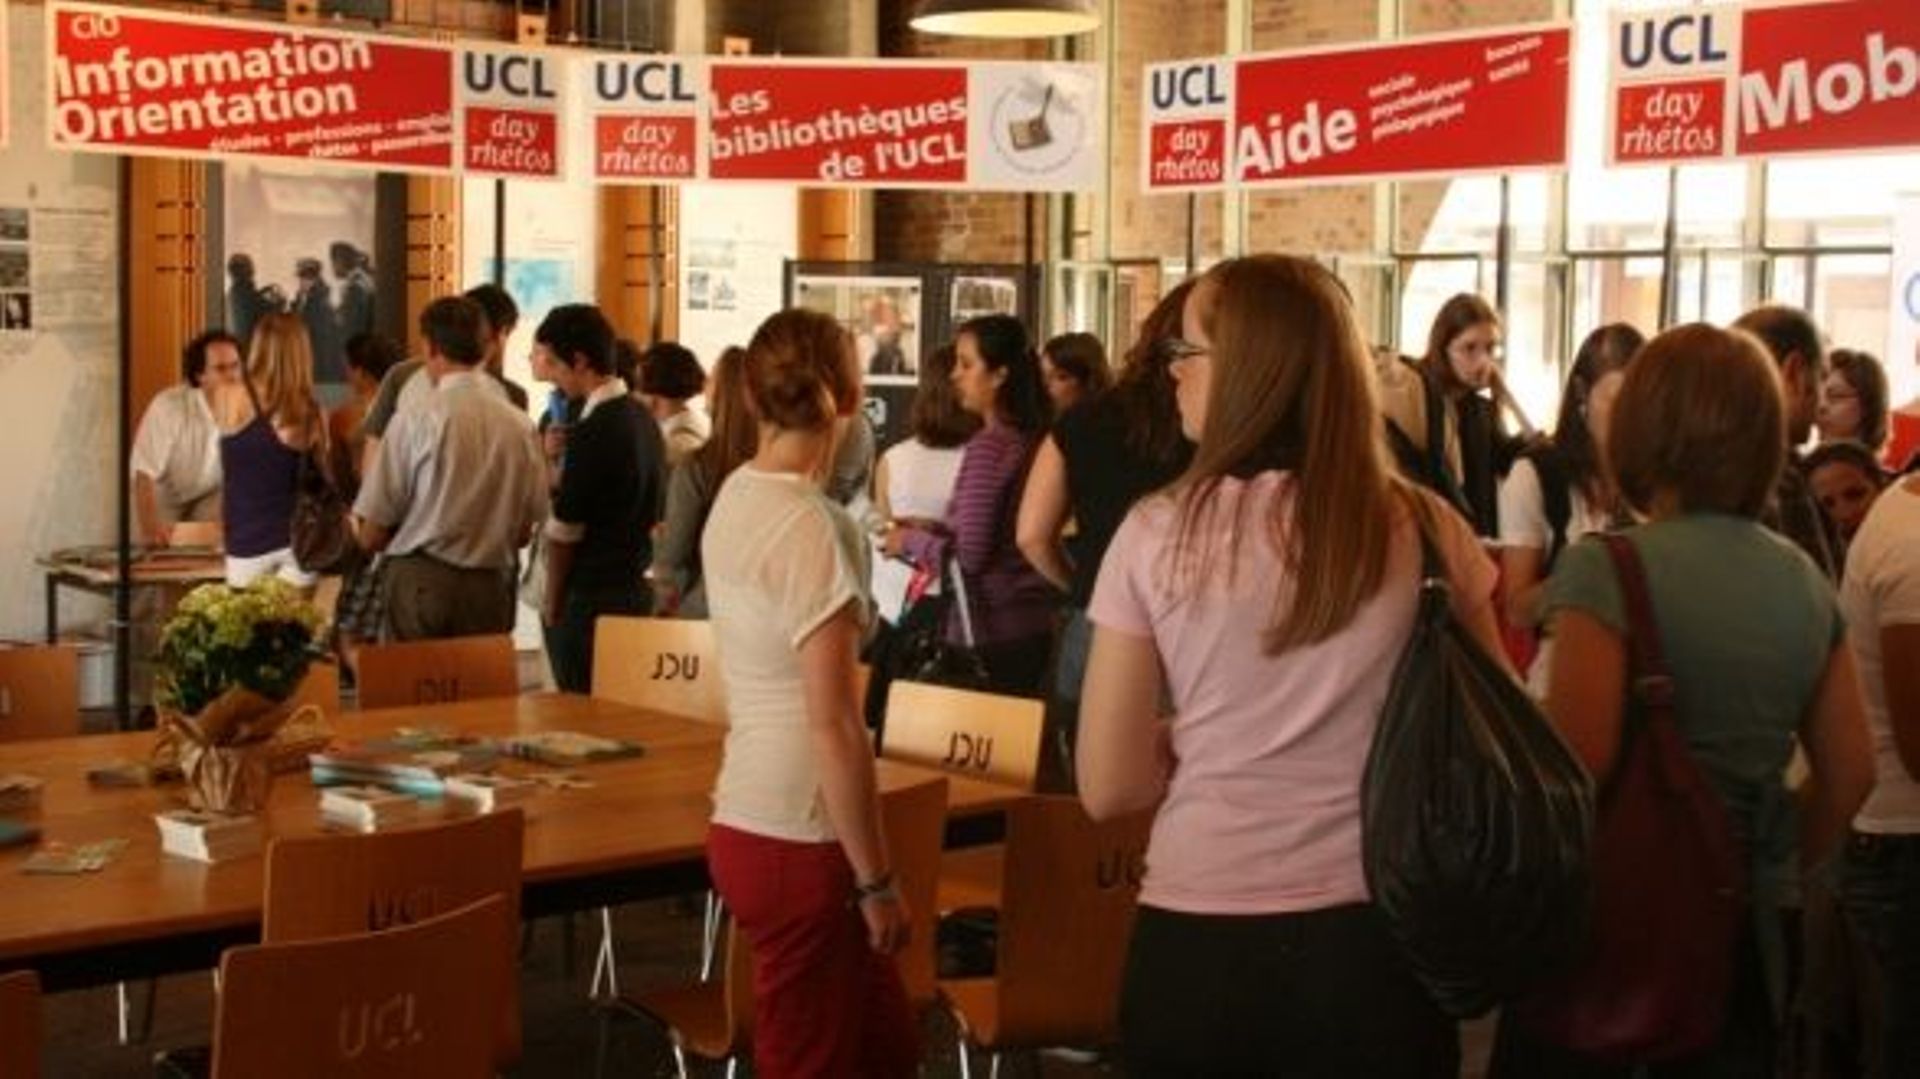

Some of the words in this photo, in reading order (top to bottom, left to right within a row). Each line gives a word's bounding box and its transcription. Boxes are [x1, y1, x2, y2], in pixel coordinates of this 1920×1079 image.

[1619, 14, 1726, 69] UCL
[55, 33, 373, 98] Information
[464, 51, 556, 98] UCL
[595, 61, 697, 102] UCL
[1152, 64, 1226, 110] UCL
[1739, 32, 1920, 135] Mob
[55, 76, 357, 143] Orientation
[711, 89, 770, 119] Les
[1644, 86, 1704, 125] day
[489, 112, 540, 146] day
[622, 118, 677, 150] day
[711, 97, 968, 160] bibliothèques
[1169, 125, 1212, 157] day
[1235, 100, 1358, 182] Aide
[1620, 121, 1716, 154] rhétos
[470, 140, 550, 171] rhétos
[602, 144, 690, 174] rhétos
[818, 150, 865, 181] de
[875, 134, 967, 174] l'UCL
[1096, 848, 1148, 890] UC
[338, 992, 425, 1059] UCL
